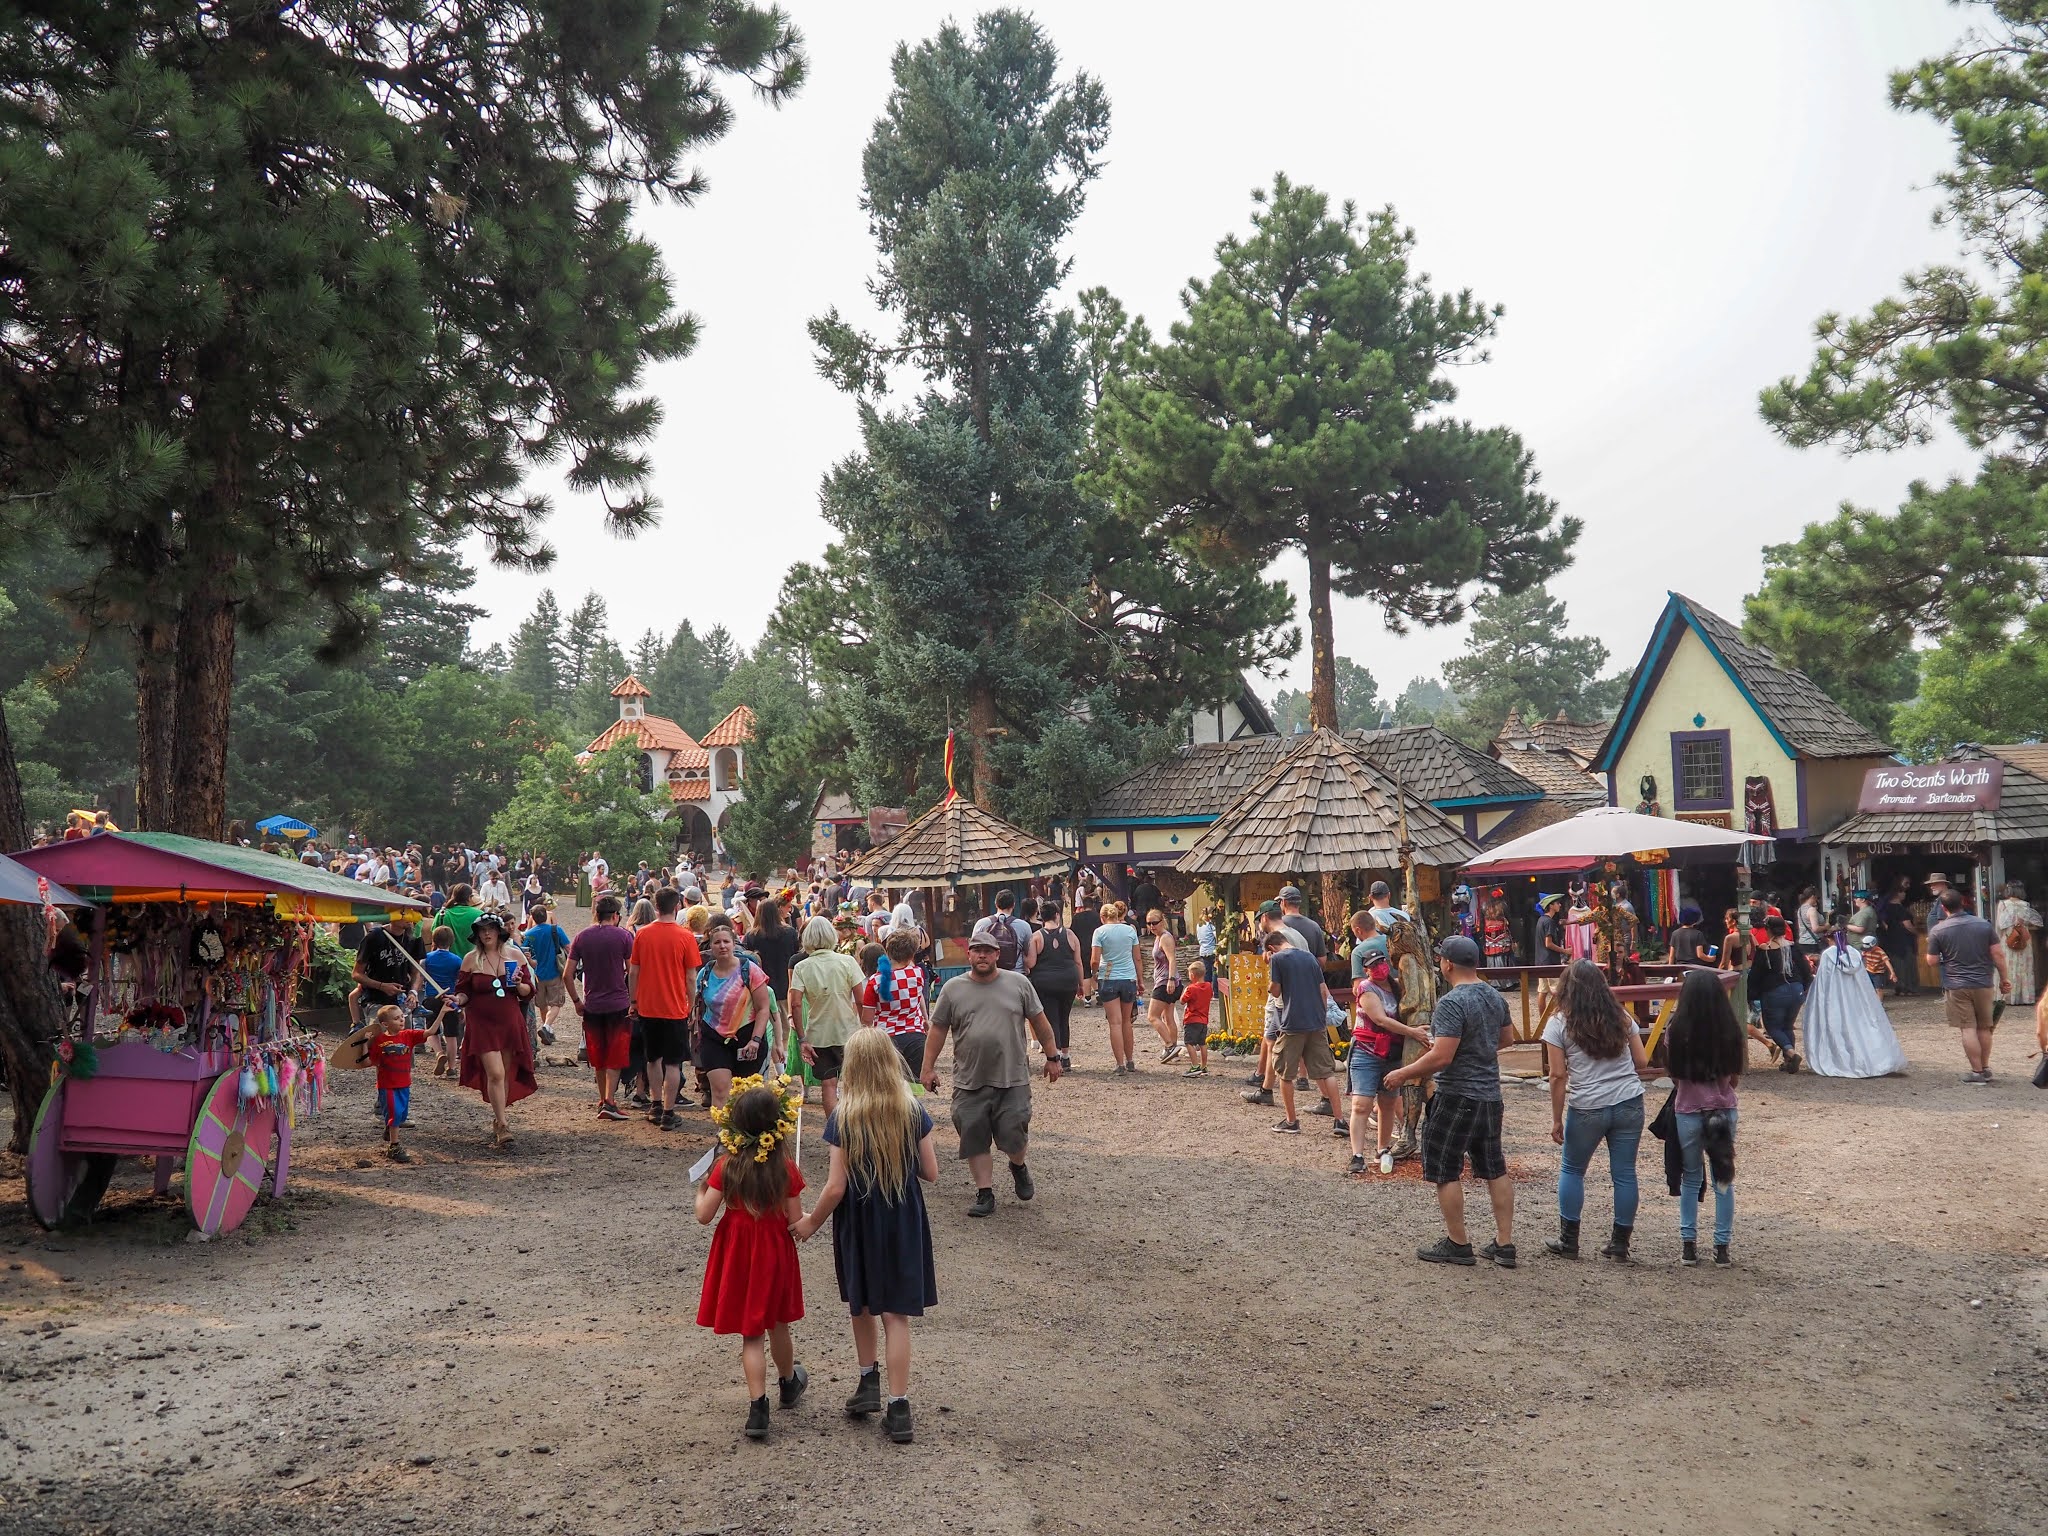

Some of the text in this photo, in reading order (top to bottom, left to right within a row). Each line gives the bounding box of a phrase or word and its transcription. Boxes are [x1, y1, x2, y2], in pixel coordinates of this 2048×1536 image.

[1875, 768, 1989, 789] Two Scents Worth
[1879, 792, 1976, 805] Aromatic Bartenders
